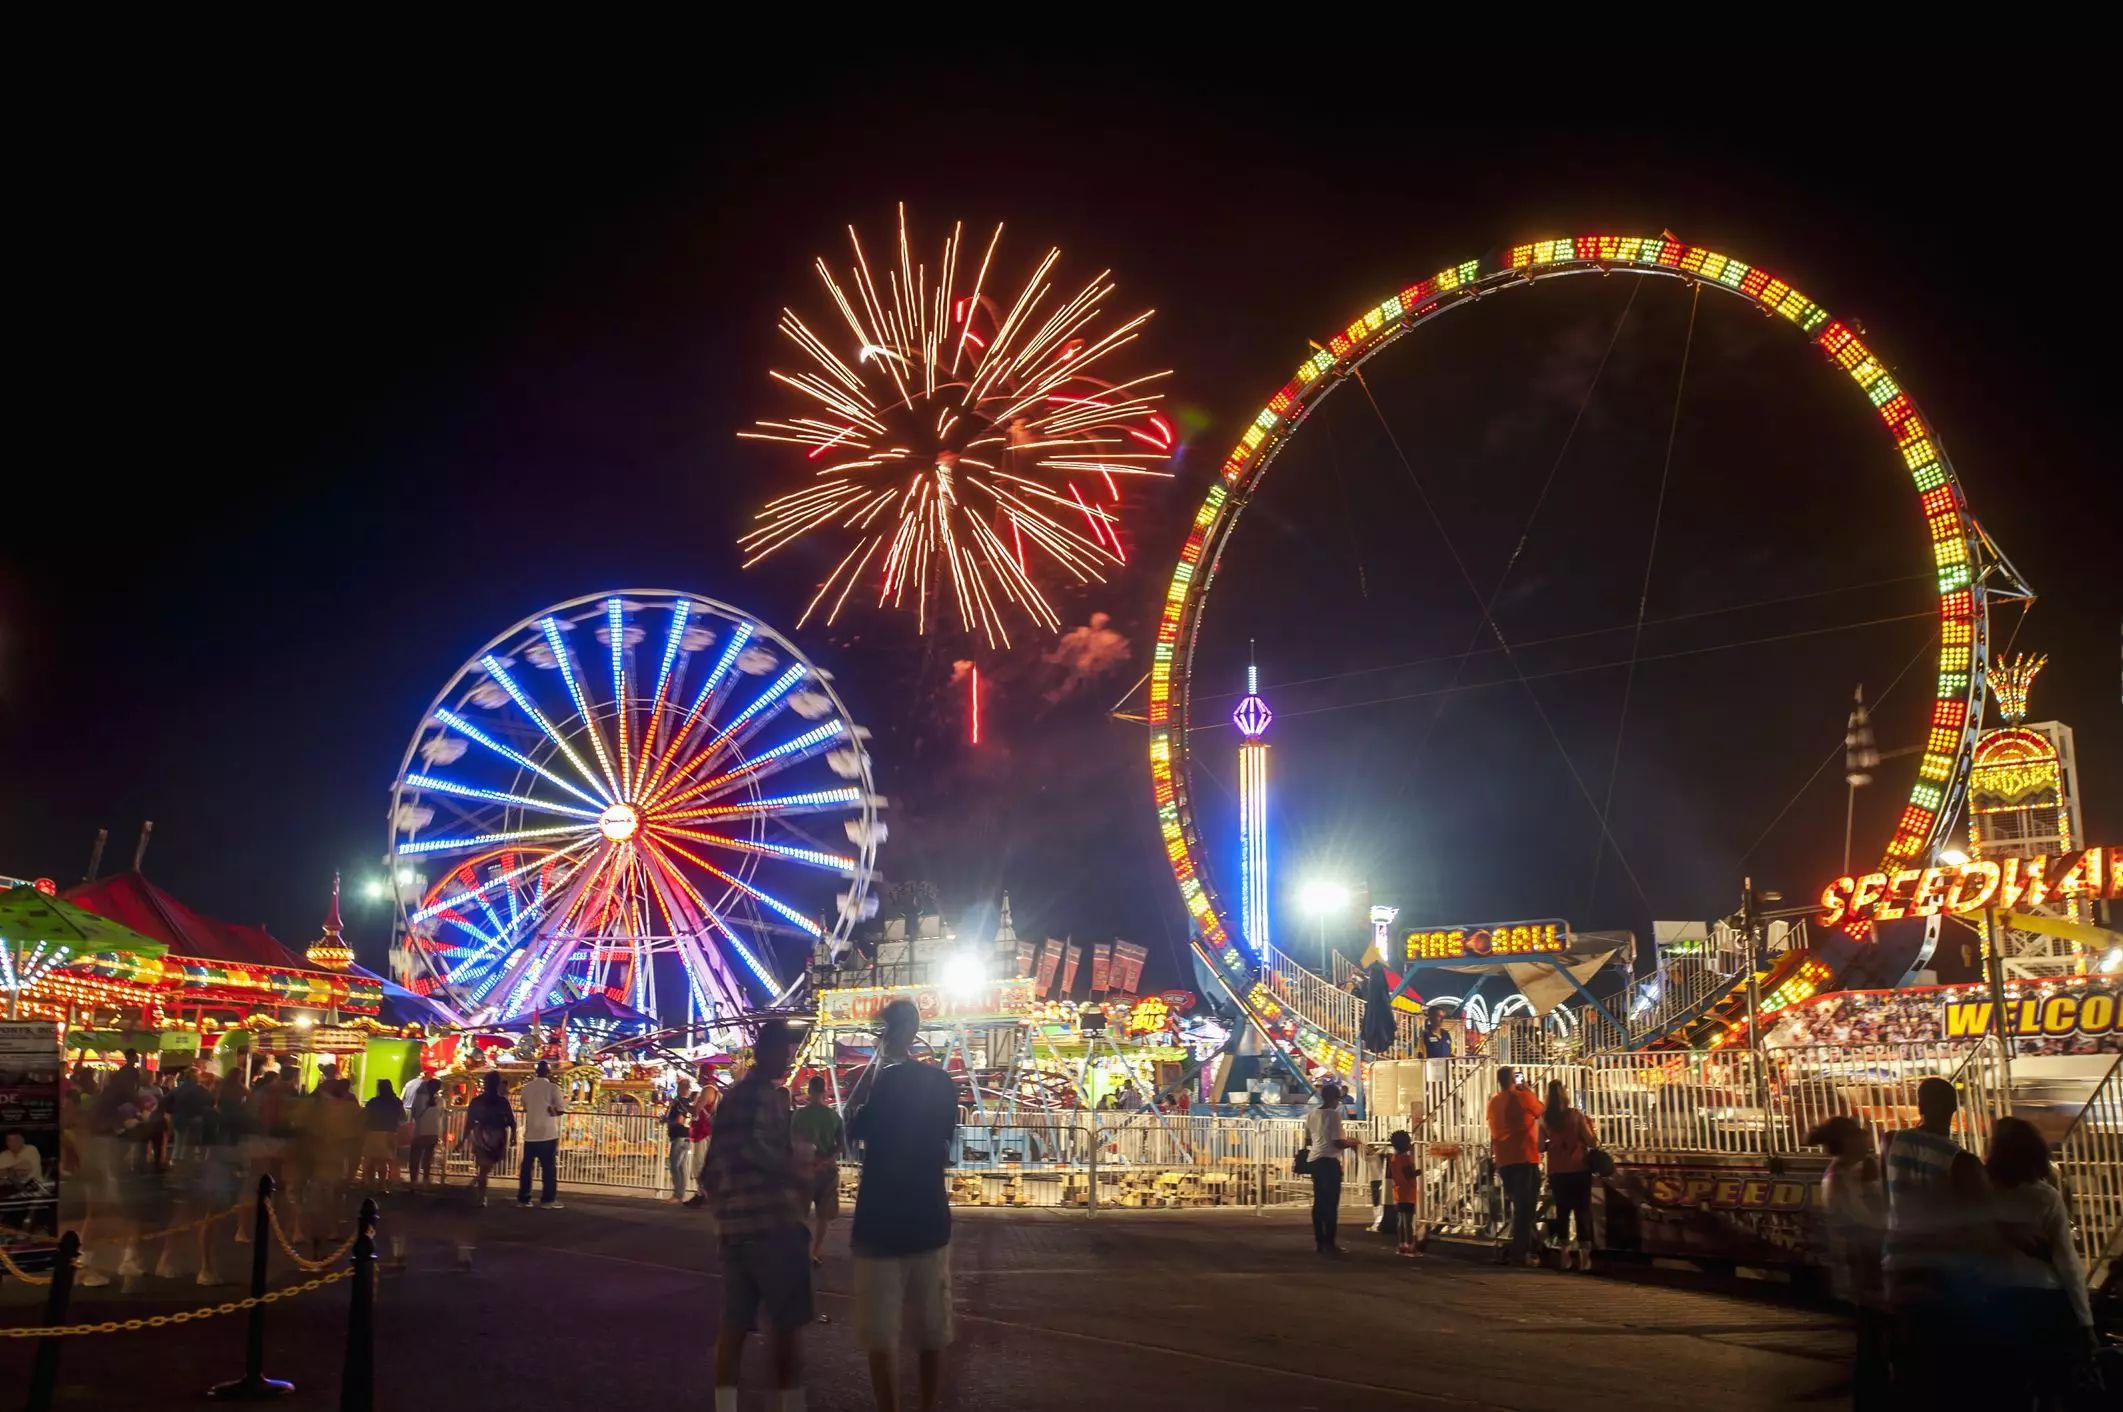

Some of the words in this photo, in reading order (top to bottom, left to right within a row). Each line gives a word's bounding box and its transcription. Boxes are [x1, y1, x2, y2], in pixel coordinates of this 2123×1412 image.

[1406, 930, 1464, 960] FIRE
[1491, 924, 1562, 955] BALL
[1132, 1014, 1167, 1031] BUS
[1945, 993, 2123, 1038] WELCO
